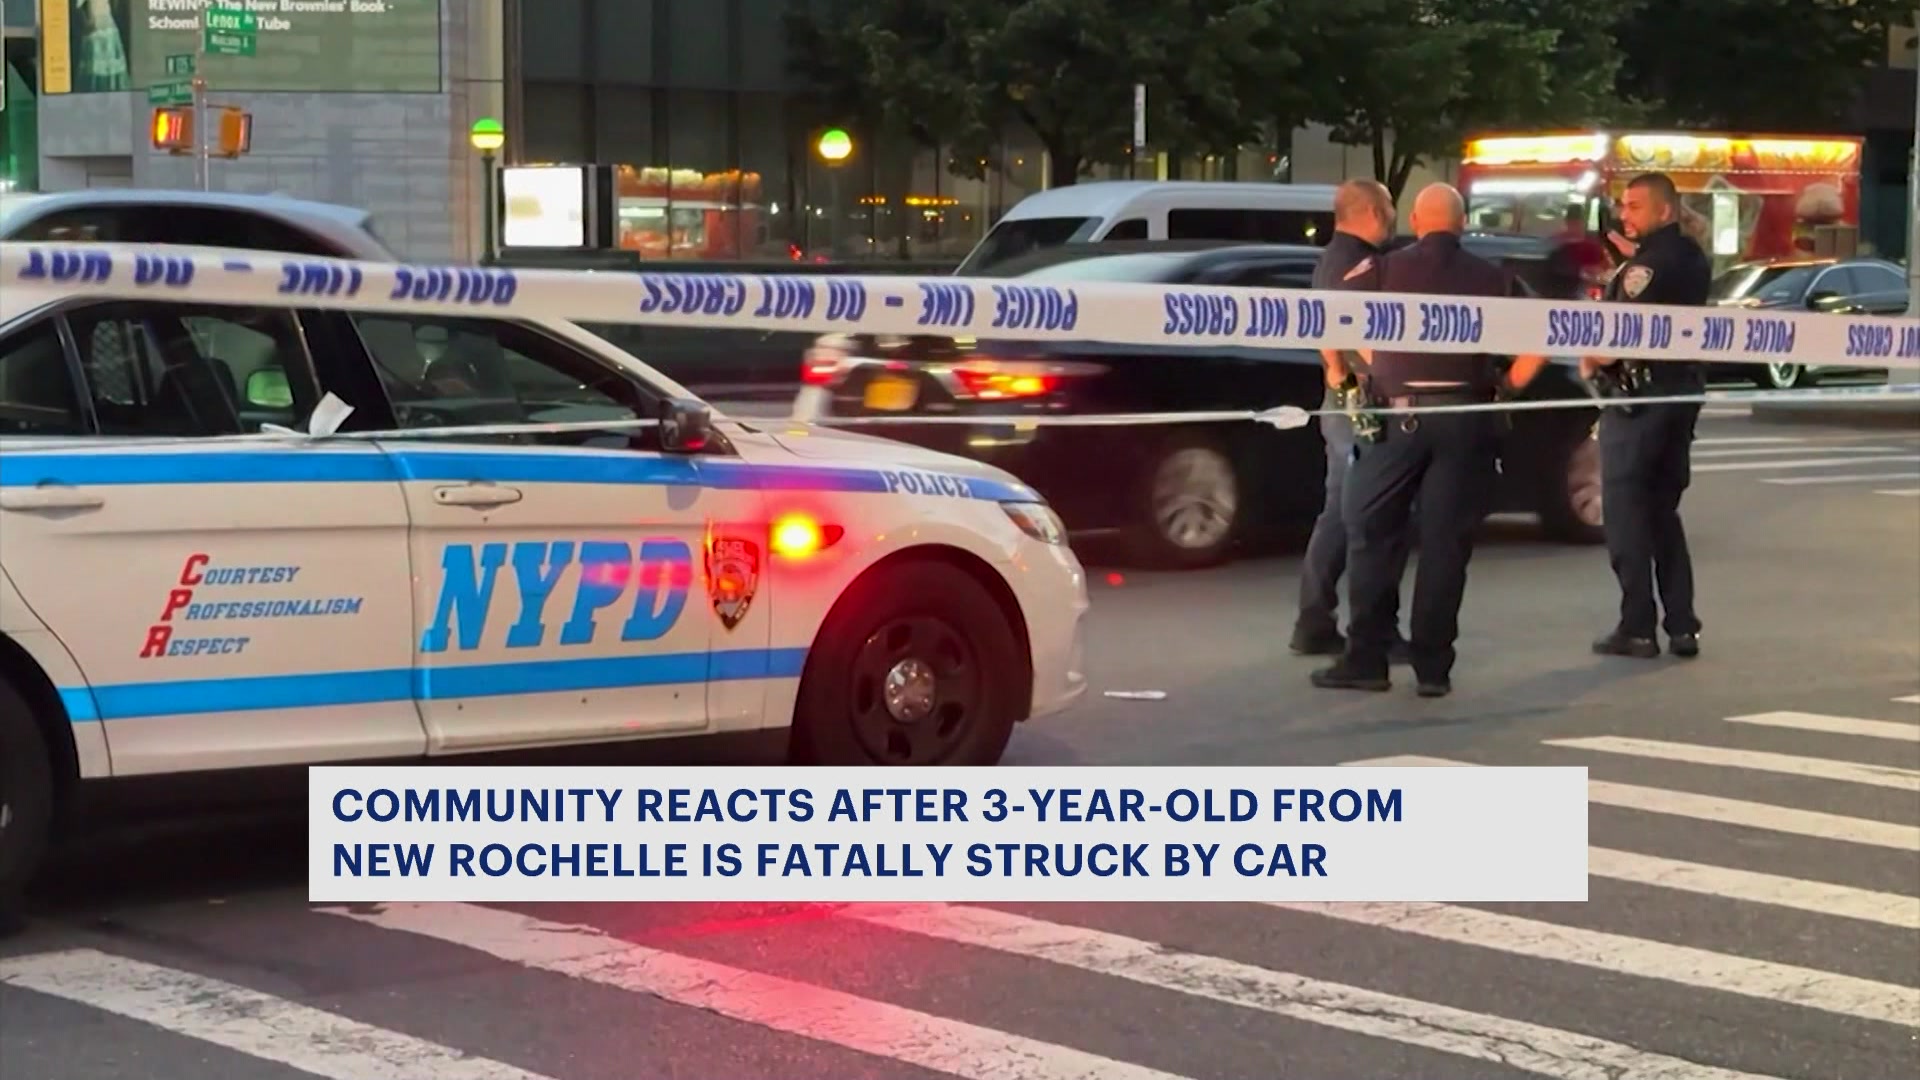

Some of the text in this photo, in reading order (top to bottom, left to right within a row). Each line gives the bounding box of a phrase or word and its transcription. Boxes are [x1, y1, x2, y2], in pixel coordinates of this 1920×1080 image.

[206, 11, 240, 29] Lenox
[245, 0, 278, 12] New
[350, 0, 386, 13] Book
[640, 274, 746, 315] CROSS
[754, 277, 818, 319] NOT
[826, 278, 867, 322] DO
[918, 282, 975, 326] LINE
[992, 284, 1079, 331] POLICE
[1162, 293, 1240, 337] CROSS
[1245, 295, 1290, 338] NOT
[1296, 298, 1327, 340] DO
[1363, 300, 1407, 342] LINE
[1417, 302, 1484, 344] POLICE
[1546, 308, 1605, 348] CROSS
[1607, 311, 1644, 348] NOT
[1648, 313, 1673, 350] DO
[1700, 315, 1736, 351] LINE
[1743, 318, 1797, 354] POLICE
[1845, 323, 1894, 357] CROSS
[881, 470, 972, 498] POLICE
[179, 554, 300, 586] COURTESY
[160, 589, 364, 621] PROFESSIONALISM
[419, 540, 692, 653] NYPD
[139, 625, 249, 658] RESPECT
